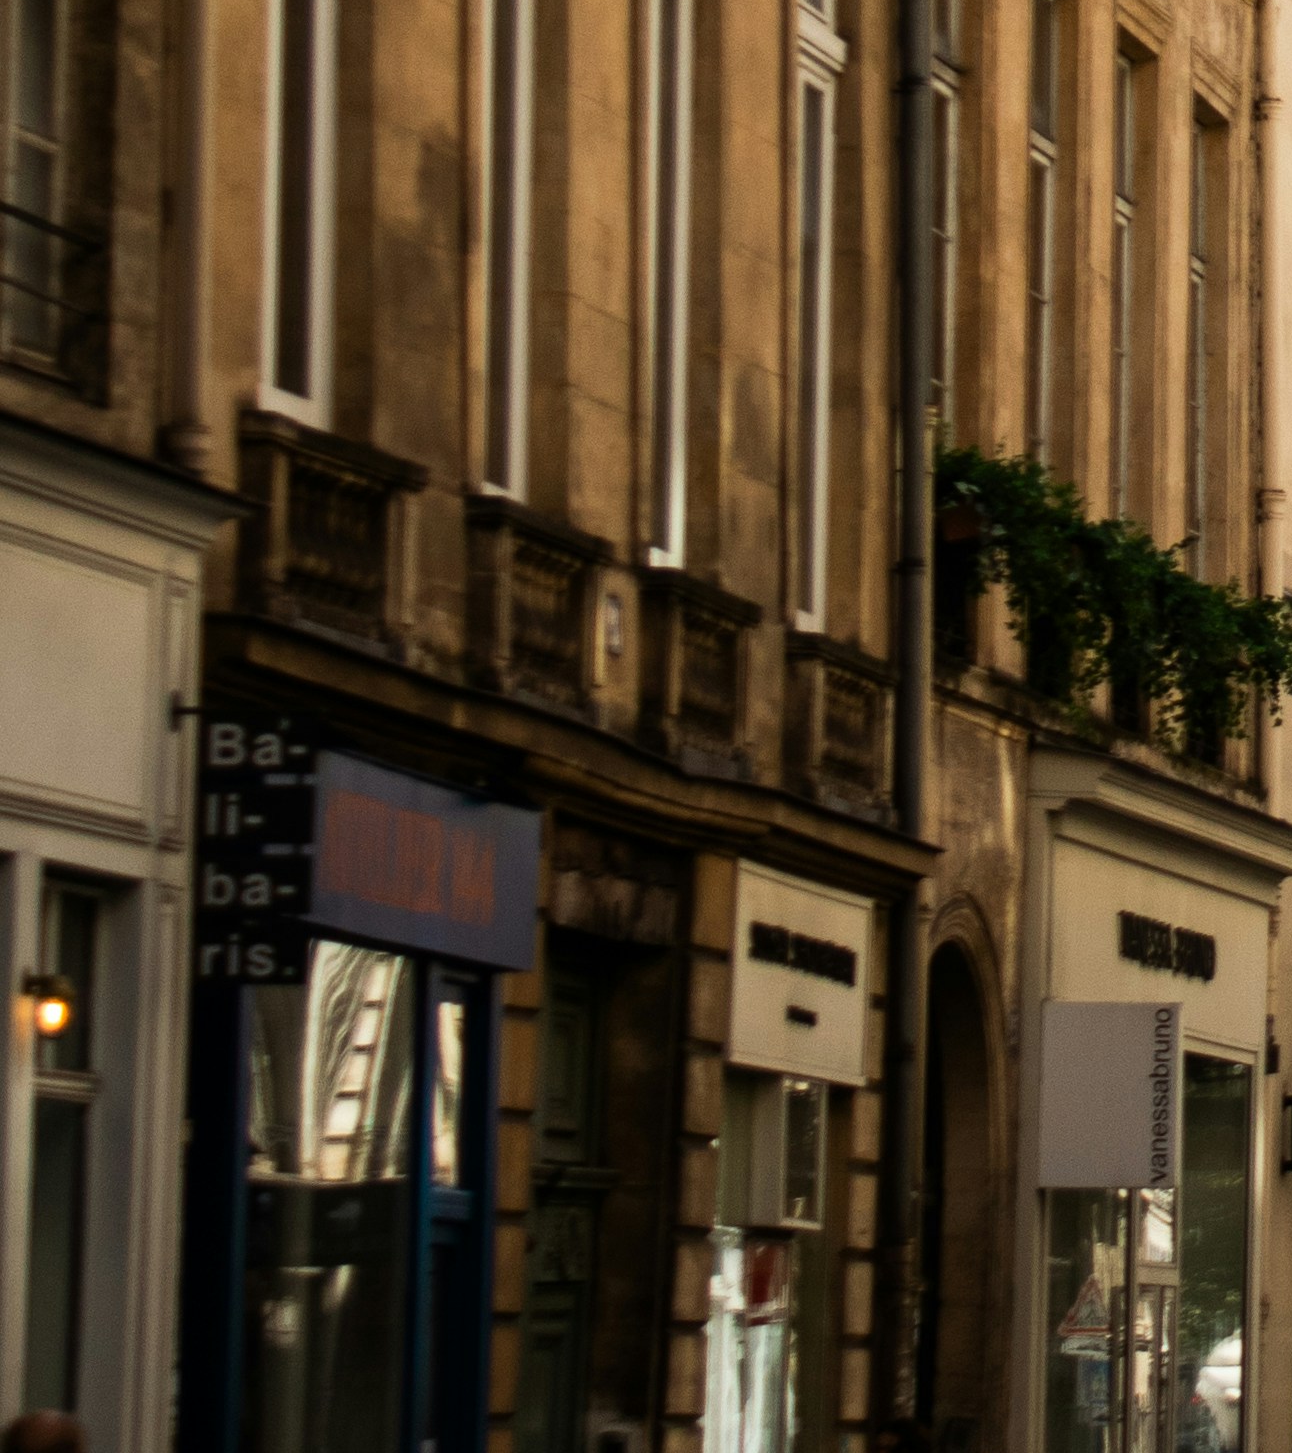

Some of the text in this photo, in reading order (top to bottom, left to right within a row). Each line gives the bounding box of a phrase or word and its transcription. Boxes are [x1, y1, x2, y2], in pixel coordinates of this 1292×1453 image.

[204, 793, 264, 835] li-
[203, 862, 296, 906] ba-
[200, 934, 295, 976] ris.
[1149, 1007, 1172, 1182] vanessabruno
